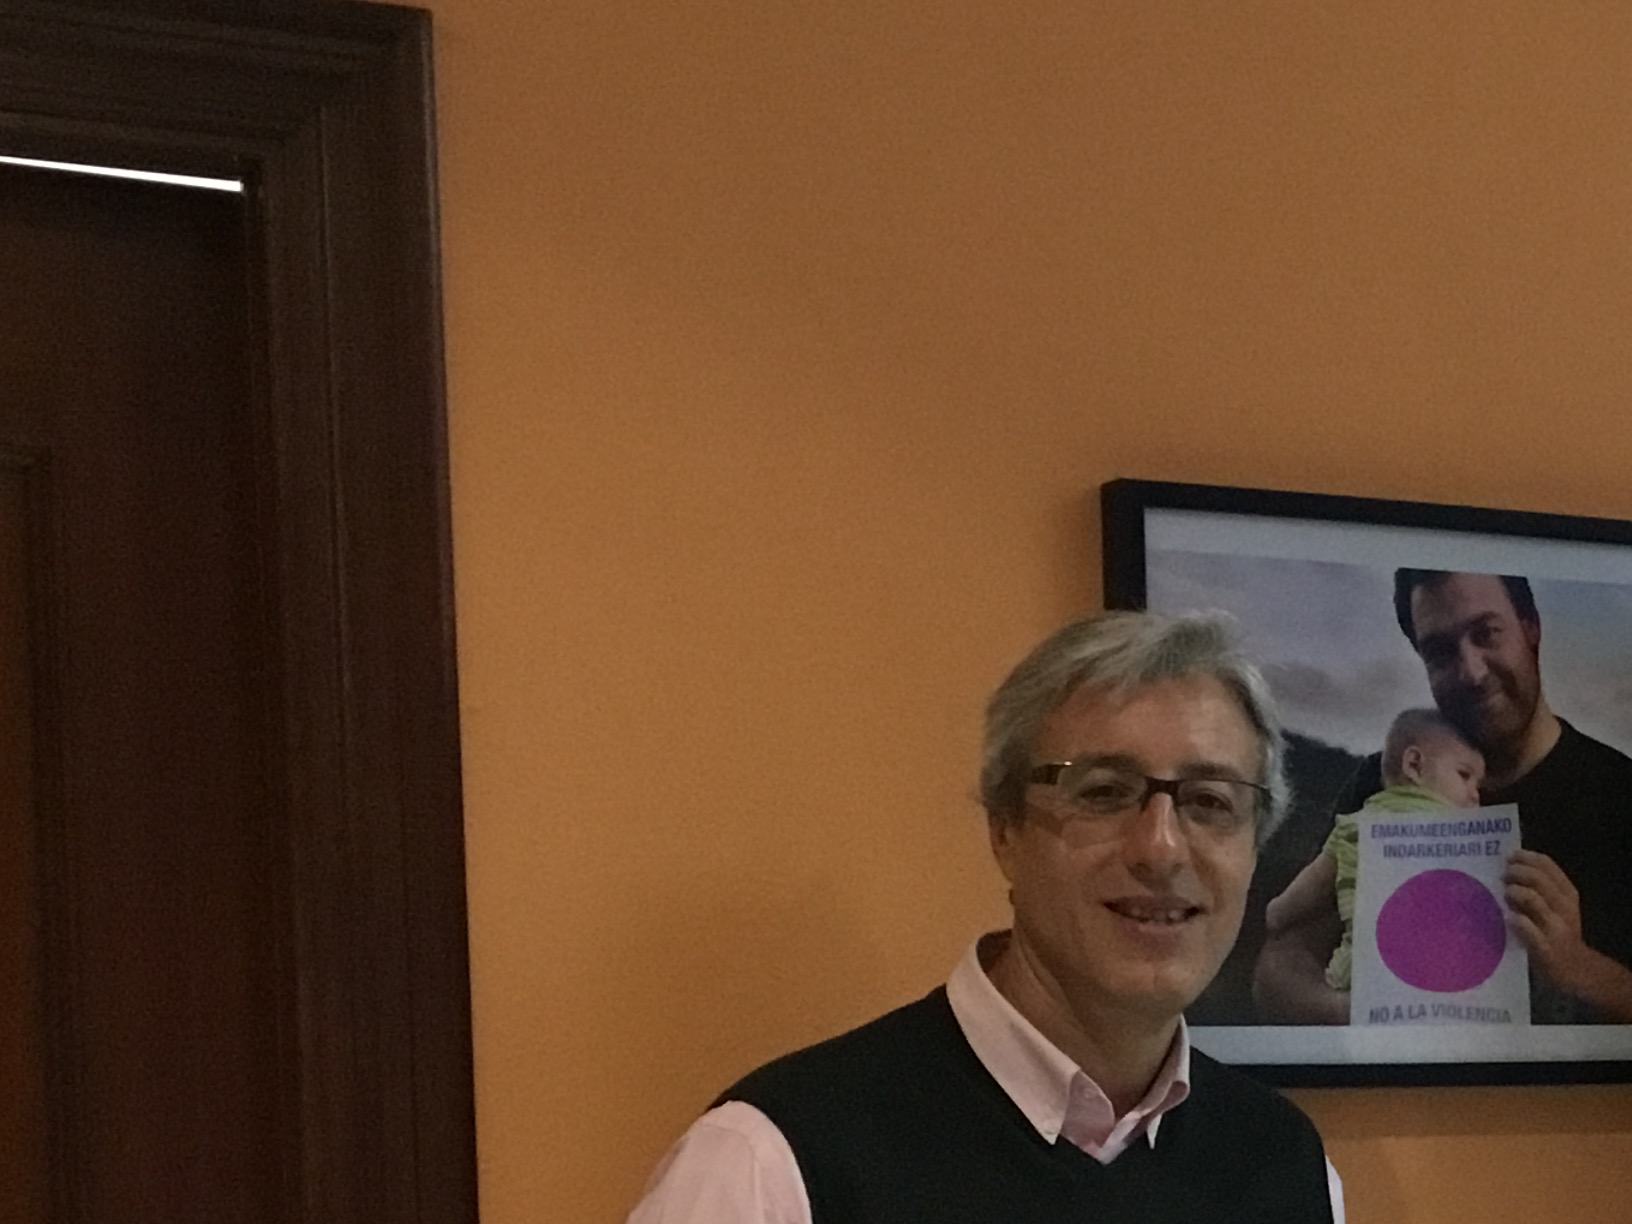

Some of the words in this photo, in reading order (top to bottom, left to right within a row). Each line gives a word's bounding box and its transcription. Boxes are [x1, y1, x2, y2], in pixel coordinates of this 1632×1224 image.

[1371, 818, 1512, 839] EMAKUMEENGANAKO
[1383, 840, 1481, 859] INDARKERIARI
[1485, 839, 1501, 856] EZ
[1368, 1006, 1390, 1024] NO
[1393, 1005, 1404, 1021] A
[1408, 1003, 1428, 1020] LA
[1431, 1002, 1512, 1024] VIOLENCIA
